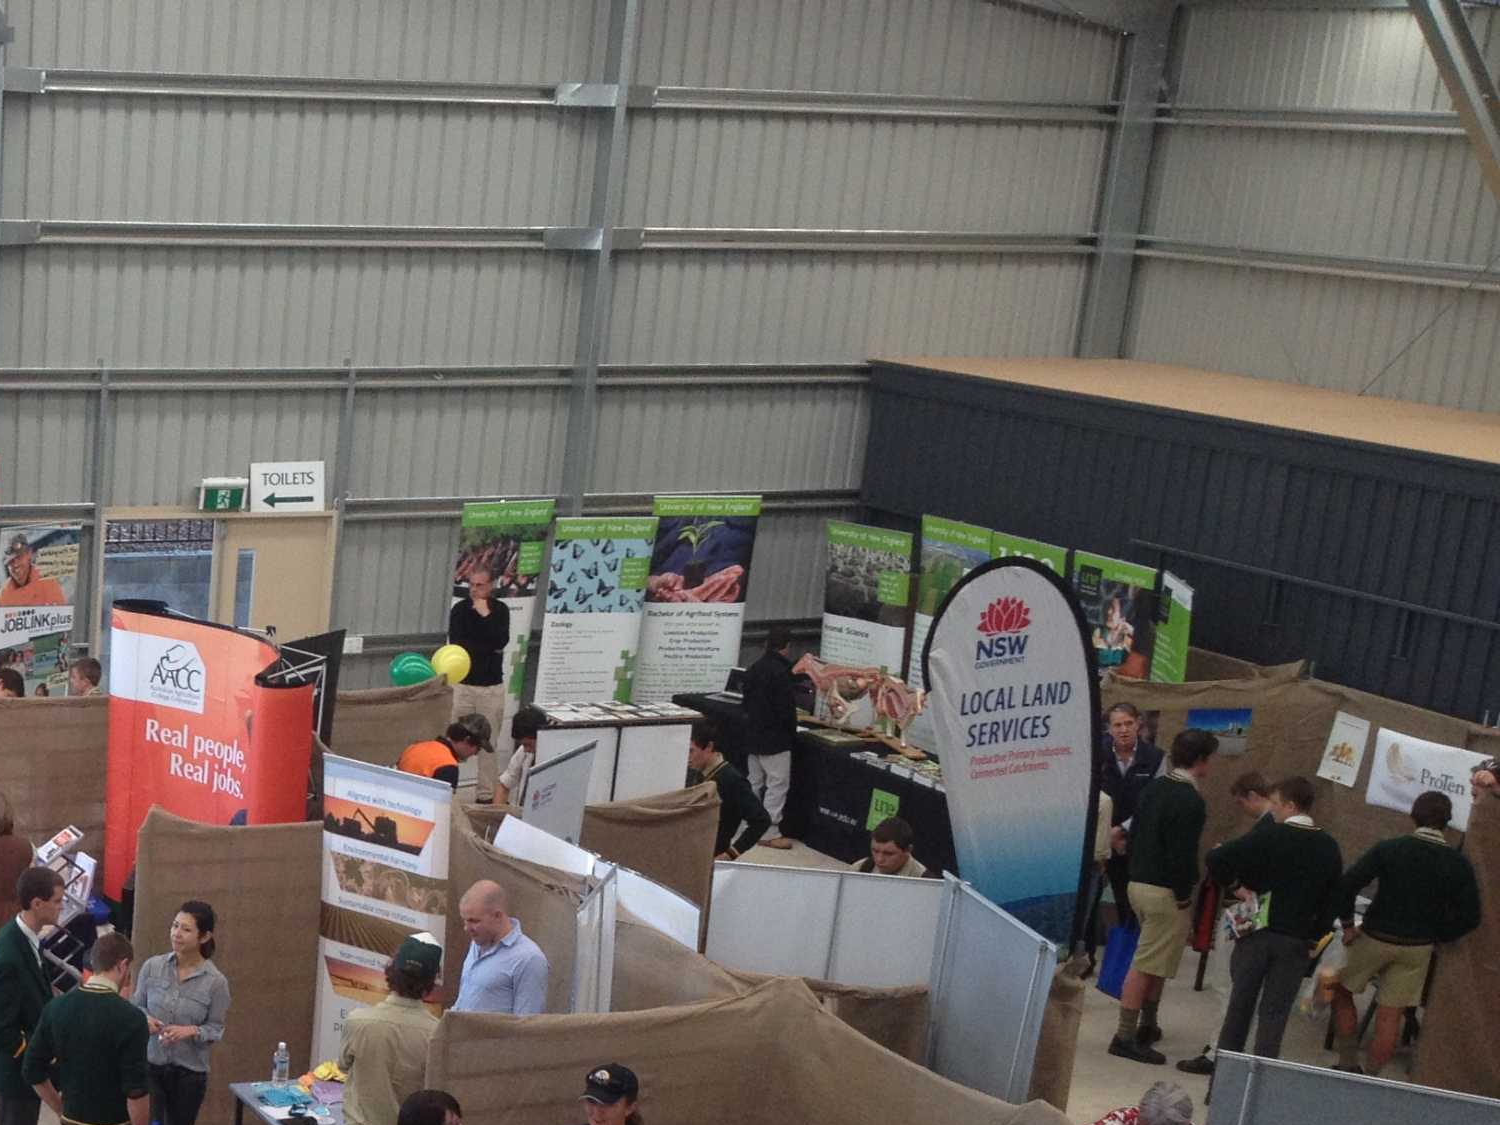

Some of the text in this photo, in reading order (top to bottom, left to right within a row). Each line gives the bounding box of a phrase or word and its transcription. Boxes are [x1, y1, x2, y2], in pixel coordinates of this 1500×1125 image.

[261, 471, 315, 486] TOILETS
[974, 656, 1025, 670] GOVERNMENT
[976, 635, 1029, 661] NSW
[960, 681, 1072, 716] LOCAL LAND
[146, 718, 246, 773] Real people,
[966, 715, 1052, 748] SERVICES
[169, 752, 244, 799] Real jobs.
[1419, 767, 1466, 796] ProTen
